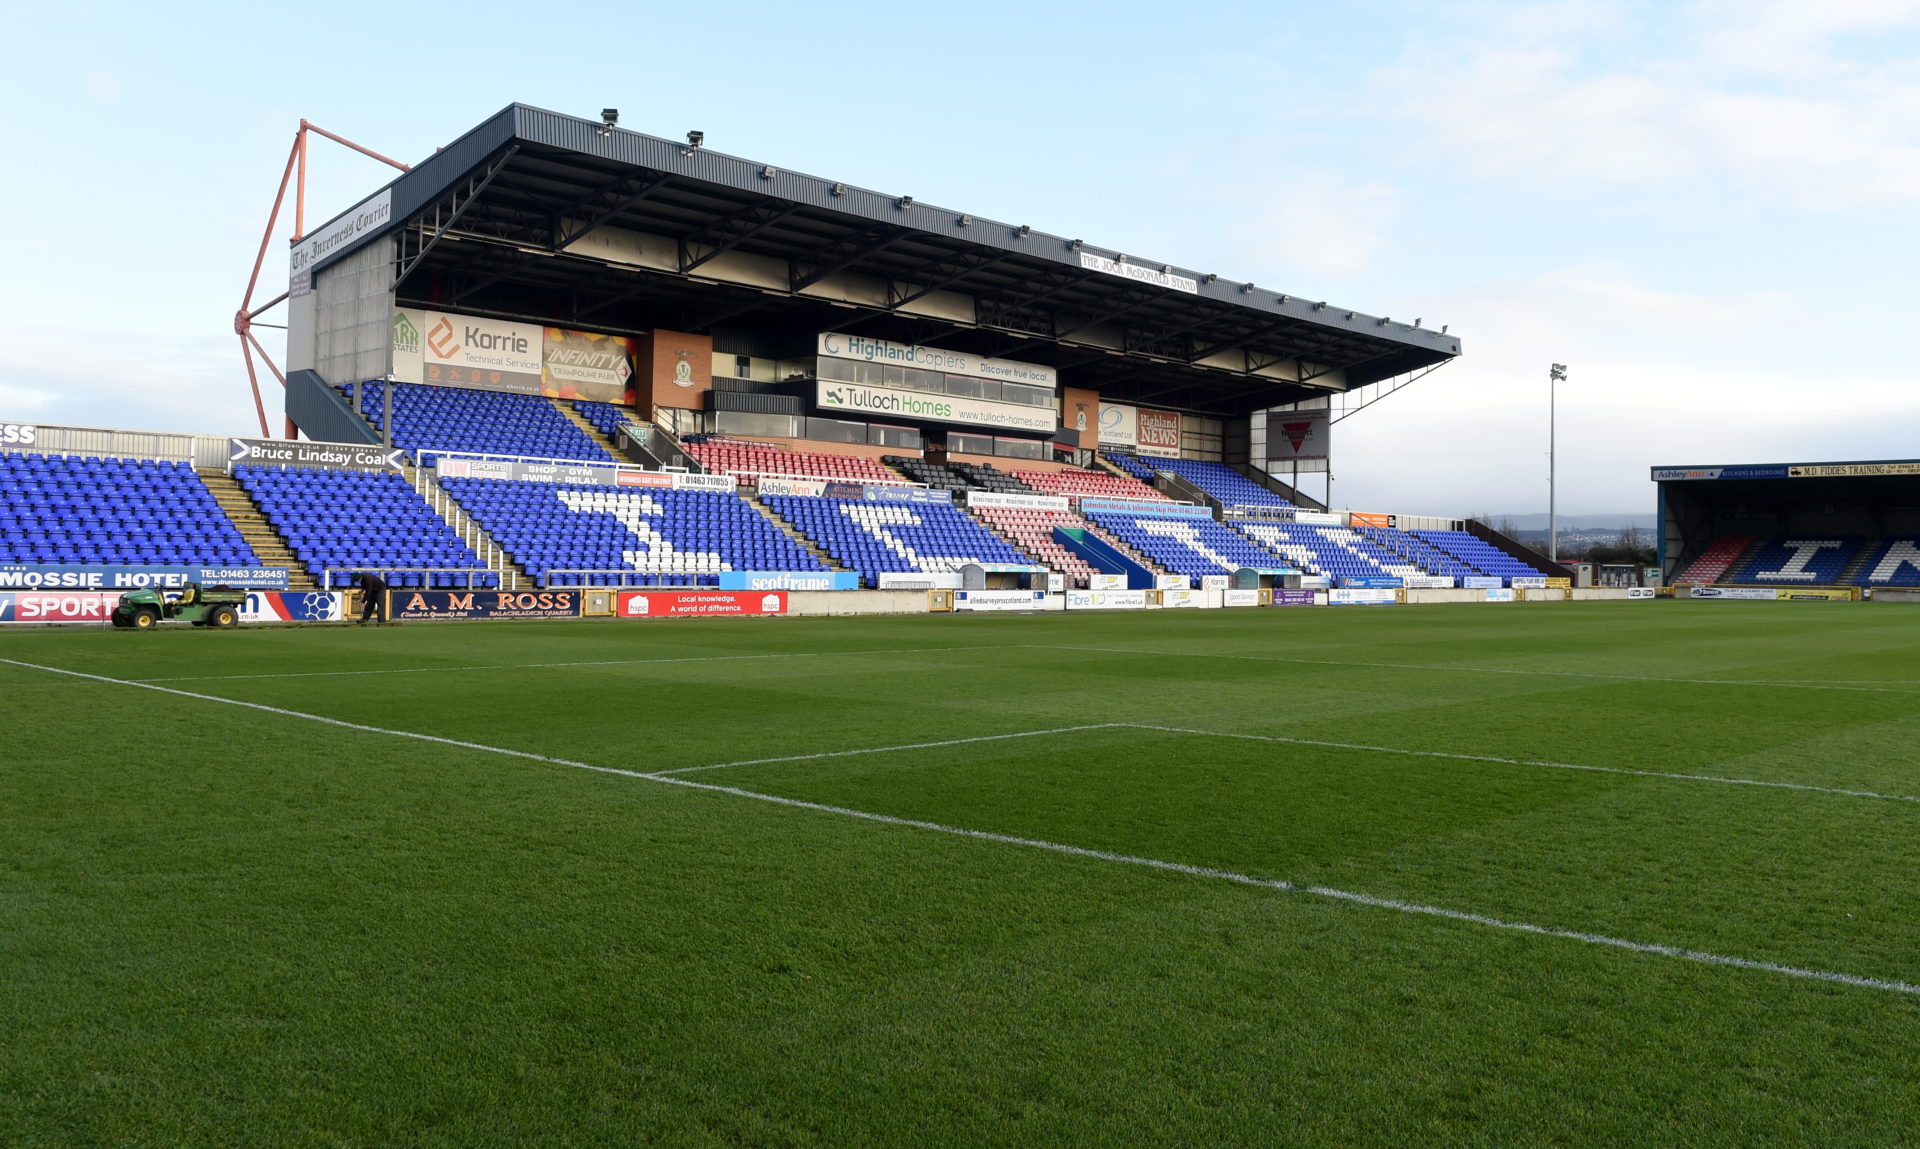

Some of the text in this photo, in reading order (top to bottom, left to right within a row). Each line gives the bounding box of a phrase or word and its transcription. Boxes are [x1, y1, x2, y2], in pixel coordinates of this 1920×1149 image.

[292, 203, 390, 270] The Inverness Courier
[1082, 254, 1196, 292] THE JOCK McDONALD STAND
[464, 326, 528, 354] Korrie
[465, 353, 540, 370] Technical Services
[548, 347, 624, 369] INFINITY
[554, 368, 615, 381] TRAMPOLINE PARK
[980, 362, 1012, 377] Discover
[1013, 367, 1028, 379] true
[846, 388, 952, 417] Tulloch Homes
[958, 408, 1051, 428] www.tulloch-homes.com
[1140, 414, 1176, 429] Highland
[0, 424, 35, 444] SS
[1102, 430, 1124, 438] Scotland
[1140, 426, 1177, 446] NEWS
[251, 445, 386, 466] Bruce Lindsay Coal
[472, 462, 506, 472] SPORTS
[528, 465, 558, 474] SHOP
[568, 468, 592, 476] GYM
[1820, 466, 1846, 475] FIDDES
[1848, 465, 1885, 474] TRAINING
[522, 474, 552, 482] SWIM
[565, 476, 598, 484] RELAX
[686, 476, 706, 485] 01463
[706, 476, 729, 486] 717055
[760, 480, 863, 496] AshleyAnn KITCHENS
[1084, 501, 1108, 510] Johnston
[1108, 502, 1126, 510] Metals
[1132, 505, 1154, 513] Johnston
[1168, 506, 1178, 514] Hire
[0, 572, 104, 587] MOSSIE
[252, 570, 286, 578] 236451
[752, 574, 830, 590] scotframe
[21, 597, 118, 617] SPORT
[406, 592, 572, 610] A. M. ROSS
[630, 604, 648, 612] hspc
[763, 602, 778, 610] hspc
